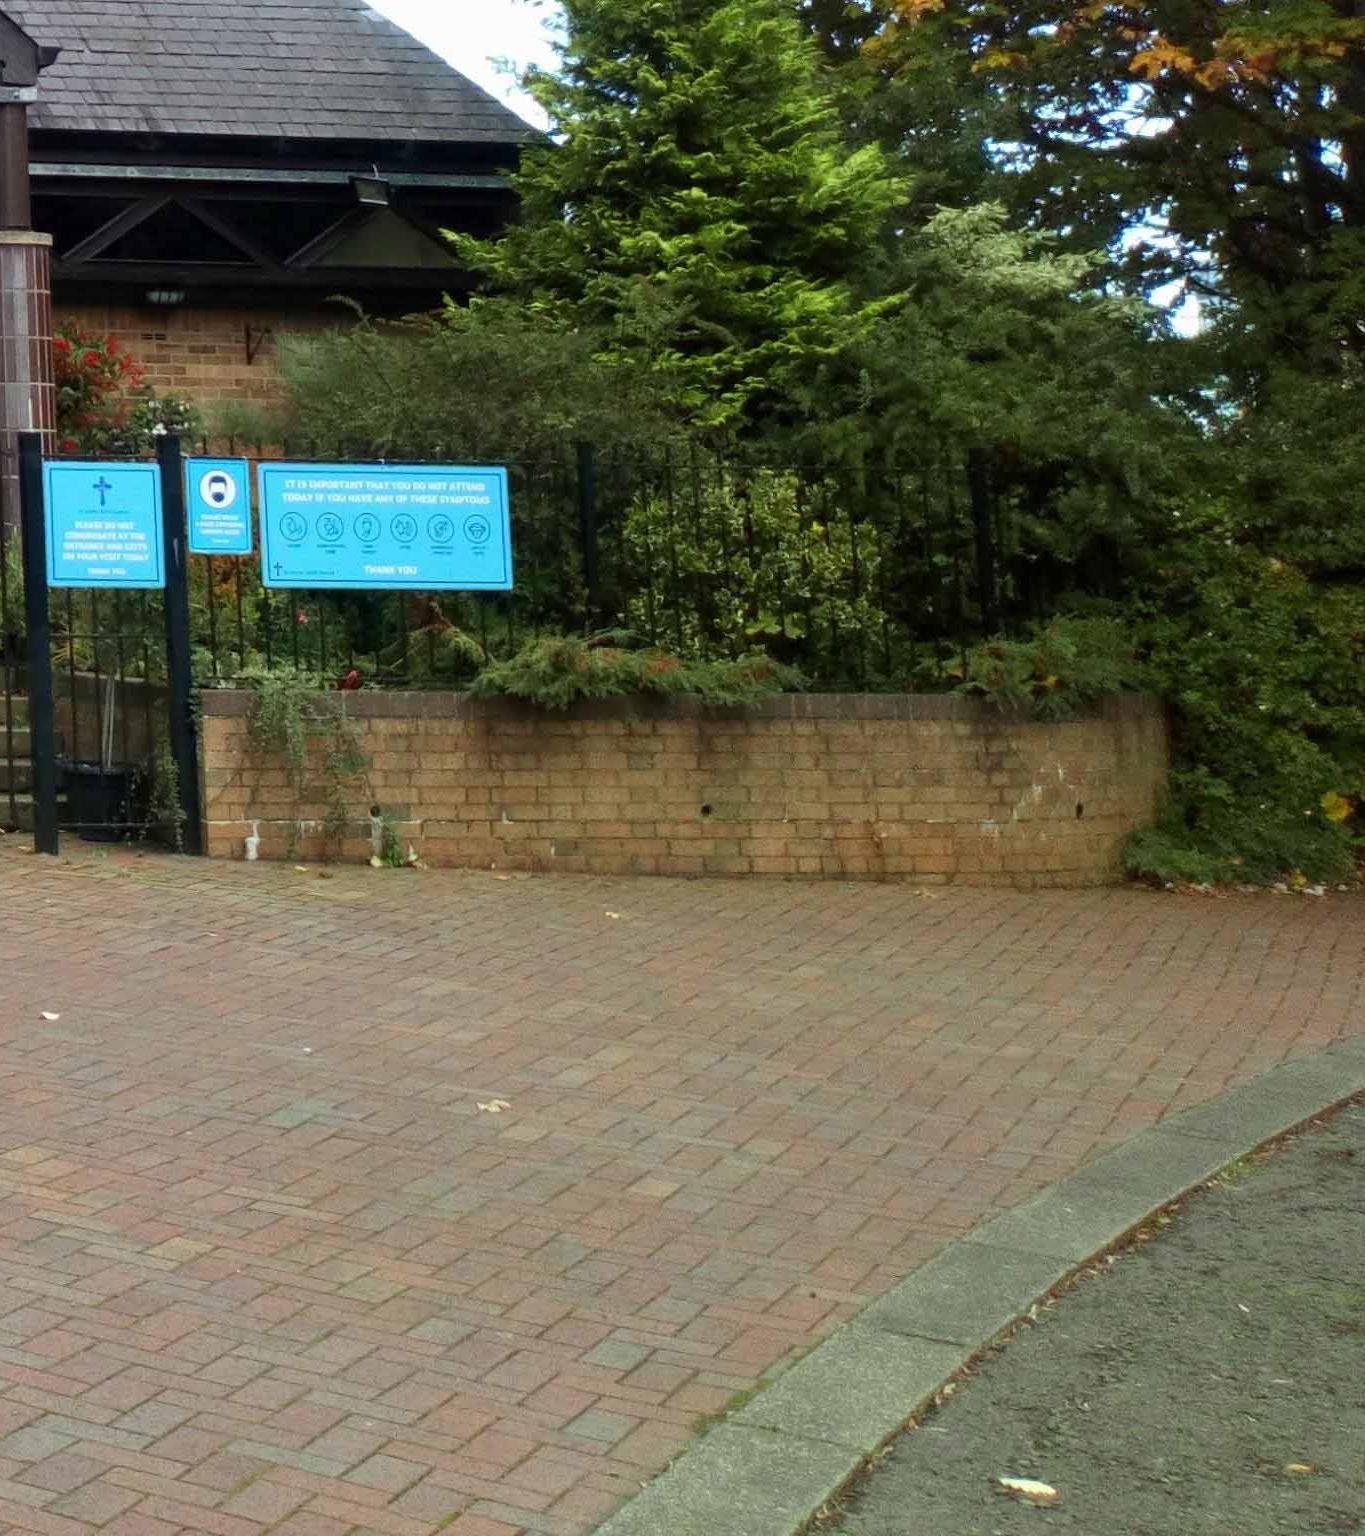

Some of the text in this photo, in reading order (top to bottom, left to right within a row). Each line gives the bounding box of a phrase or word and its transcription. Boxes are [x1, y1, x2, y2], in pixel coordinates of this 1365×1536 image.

[308, 479, 363, 490] IMPORTANT
[365, 480, 389, 490] THAT
[391, 481, 411, 491] YOU
[412, 481, 426, 490] DO
[427, 482, 447, 491] NOT
[449, 482, 486, 492] ATTEND
[282, 492, 313, 503] TODAY
[326, 493, 346, 503] YOU
[347, 494, 372, 504] HAVE
[395, 495, 407, 505] OF
[409, 495, 437, 505] THESE
[439, 495, 491, 506] SYMPTOMS
[364, 565, 418, 576] THANK YOU
